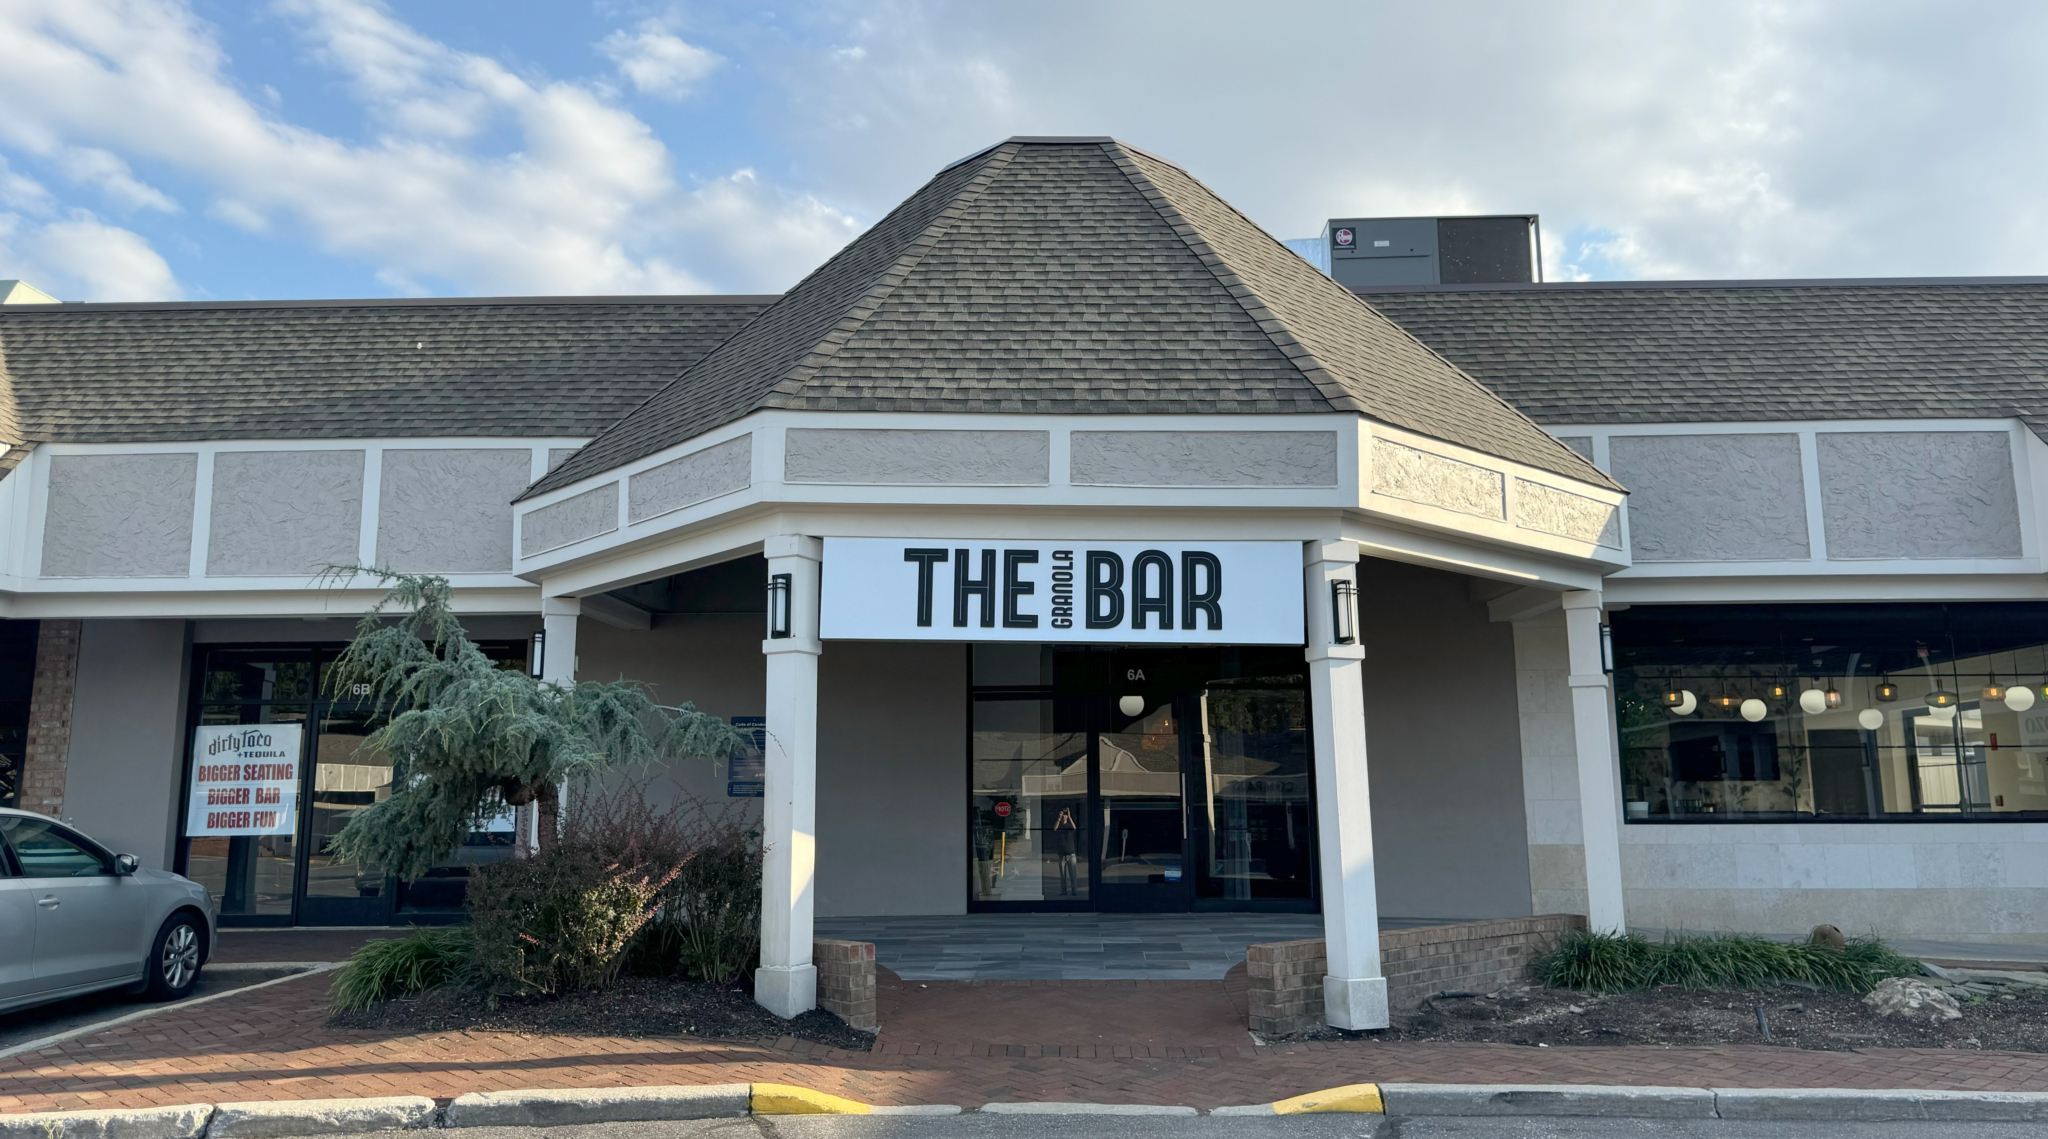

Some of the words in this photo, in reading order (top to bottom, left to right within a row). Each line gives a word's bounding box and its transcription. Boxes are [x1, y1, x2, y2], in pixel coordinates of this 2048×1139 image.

[904, 548, 1039, 628] THE
[1051, 550, 1074, 629] GRANOLA
[1086, 549, 1223, 630] BAR
[1127, 669, 1146, 681] 6A
[352, 683, 371, 695] 6B
[198, 765, 241, 782] BIGGER
[243, 763, 294, 781] SEATING
[207, 788, 251, 806] BIGGER
[255, 787, 281, 804] BAR
[206, 811, 251, 829] BIGGER
[253, 810, 277, 828] FUN
